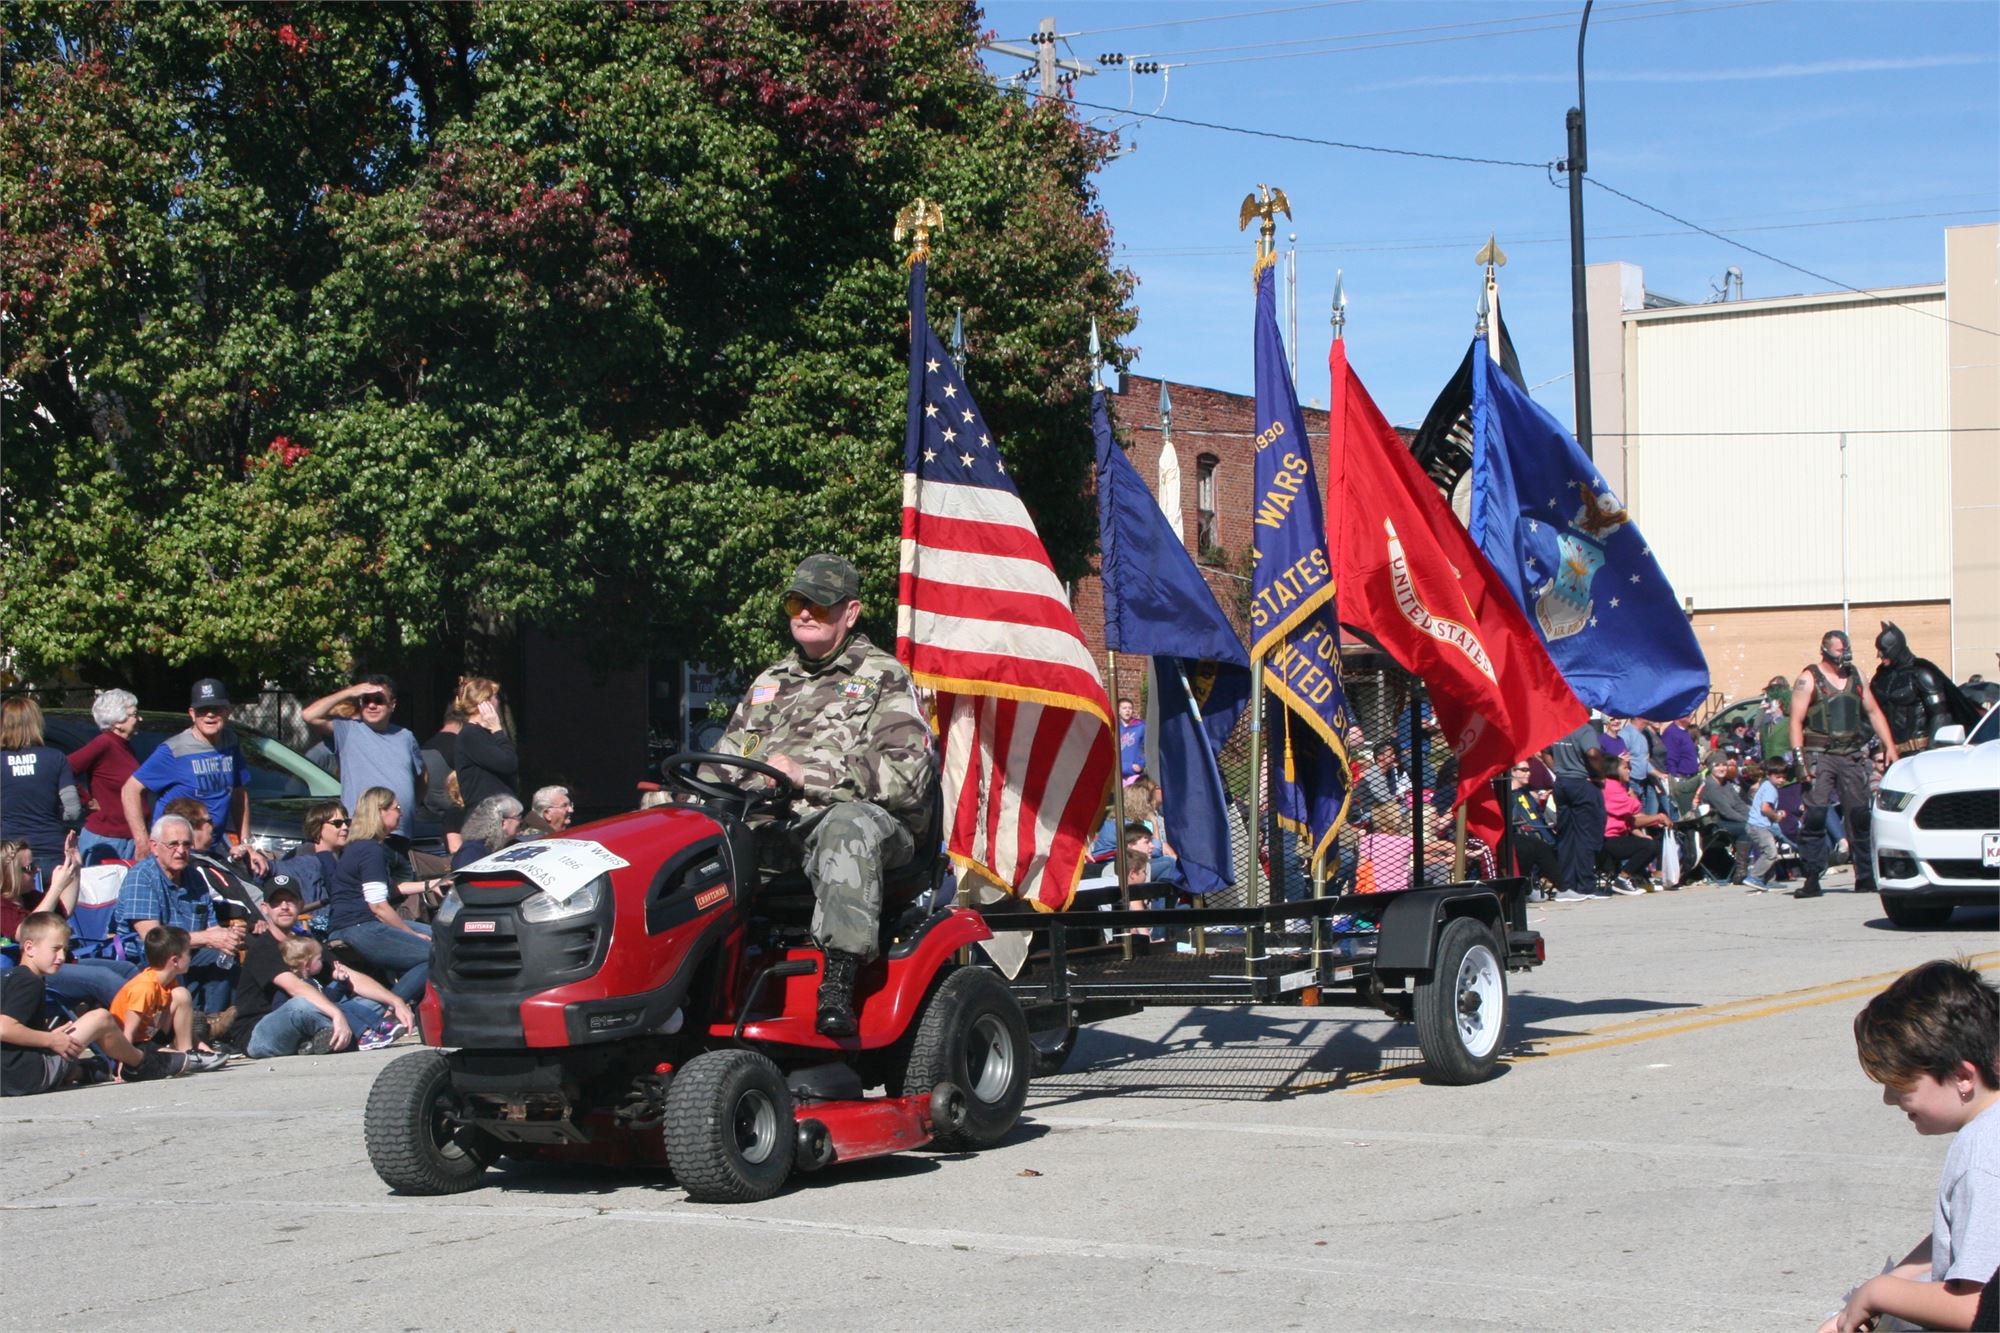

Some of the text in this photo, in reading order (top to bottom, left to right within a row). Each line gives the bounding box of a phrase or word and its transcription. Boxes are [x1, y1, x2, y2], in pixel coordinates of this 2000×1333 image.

[1255, 453, 1309, 529] WARS
[1251, 548, 1329, 627] STATES
[1393, 557, 1490, 672] UNITED STATES
[1270, 643, 1333, 704] NITED
[7, 753, 37, 766] BAND
[12, 764, 35, 777] MOM
[558, 855, 584, 870] 1186
